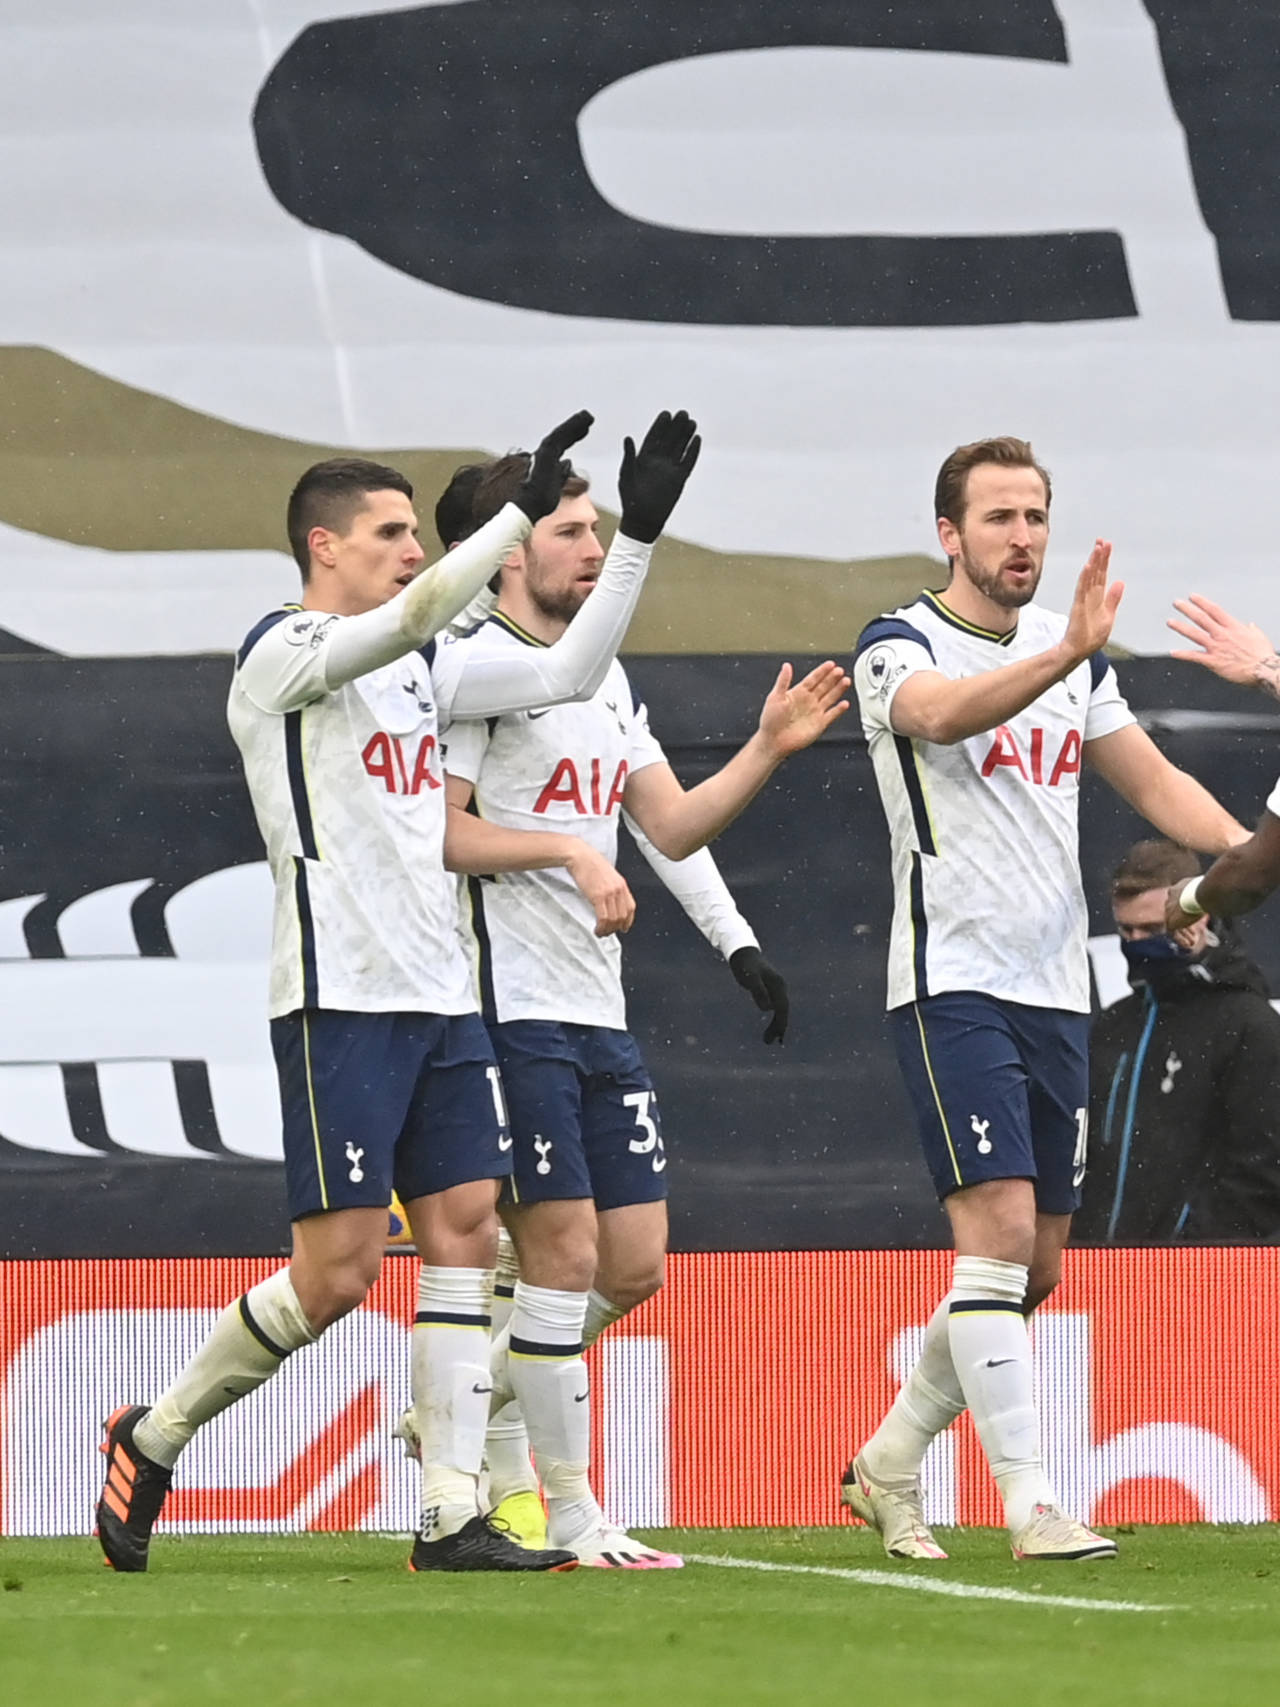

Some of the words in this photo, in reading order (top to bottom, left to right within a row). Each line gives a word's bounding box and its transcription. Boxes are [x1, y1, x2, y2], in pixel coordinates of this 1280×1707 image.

[361, 731, 443, 796] AIA
[532, 757, 629, 816] AIA
[981, 725, 1082, 787] AIA
